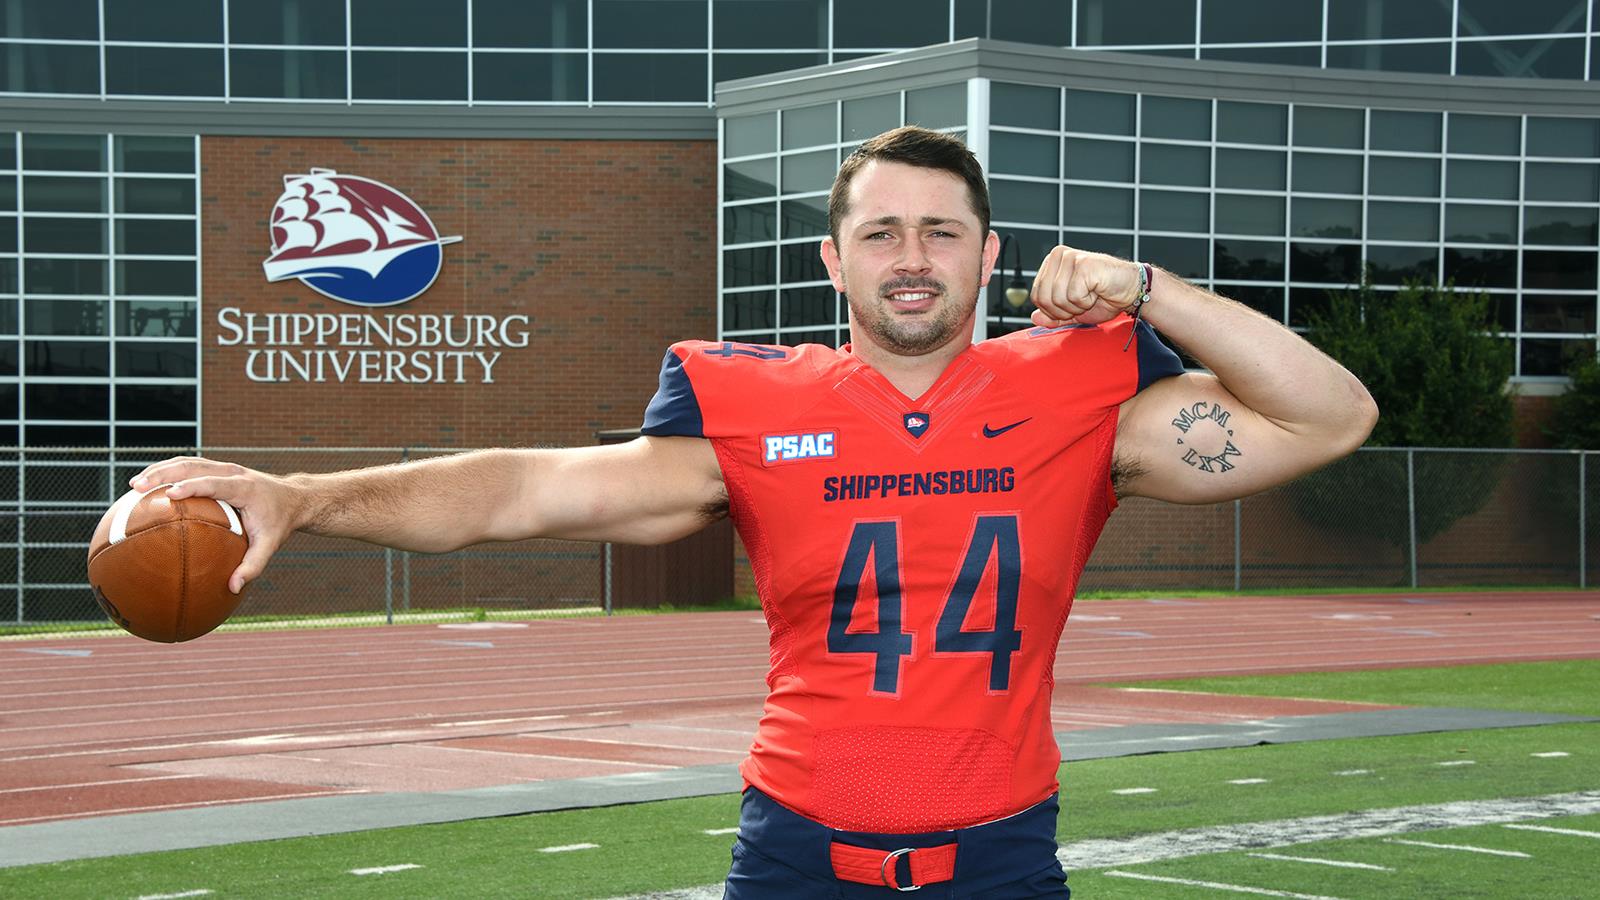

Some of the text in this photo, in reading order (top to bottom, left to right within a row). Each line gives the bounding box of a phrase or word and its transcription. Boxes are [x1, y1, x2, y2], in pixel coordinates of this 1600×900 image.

[216, 306, 531, 348] SHIPPENSBURG
[245, 349, 502, 384] UNIVERSITY
[1171, 401, 1232, 434] MCM
[765, 431, 835, 463] PSAC
[823, 466, 1016, 502] SHIPPENSBURG
[826, 512, 1025, 696] 44
